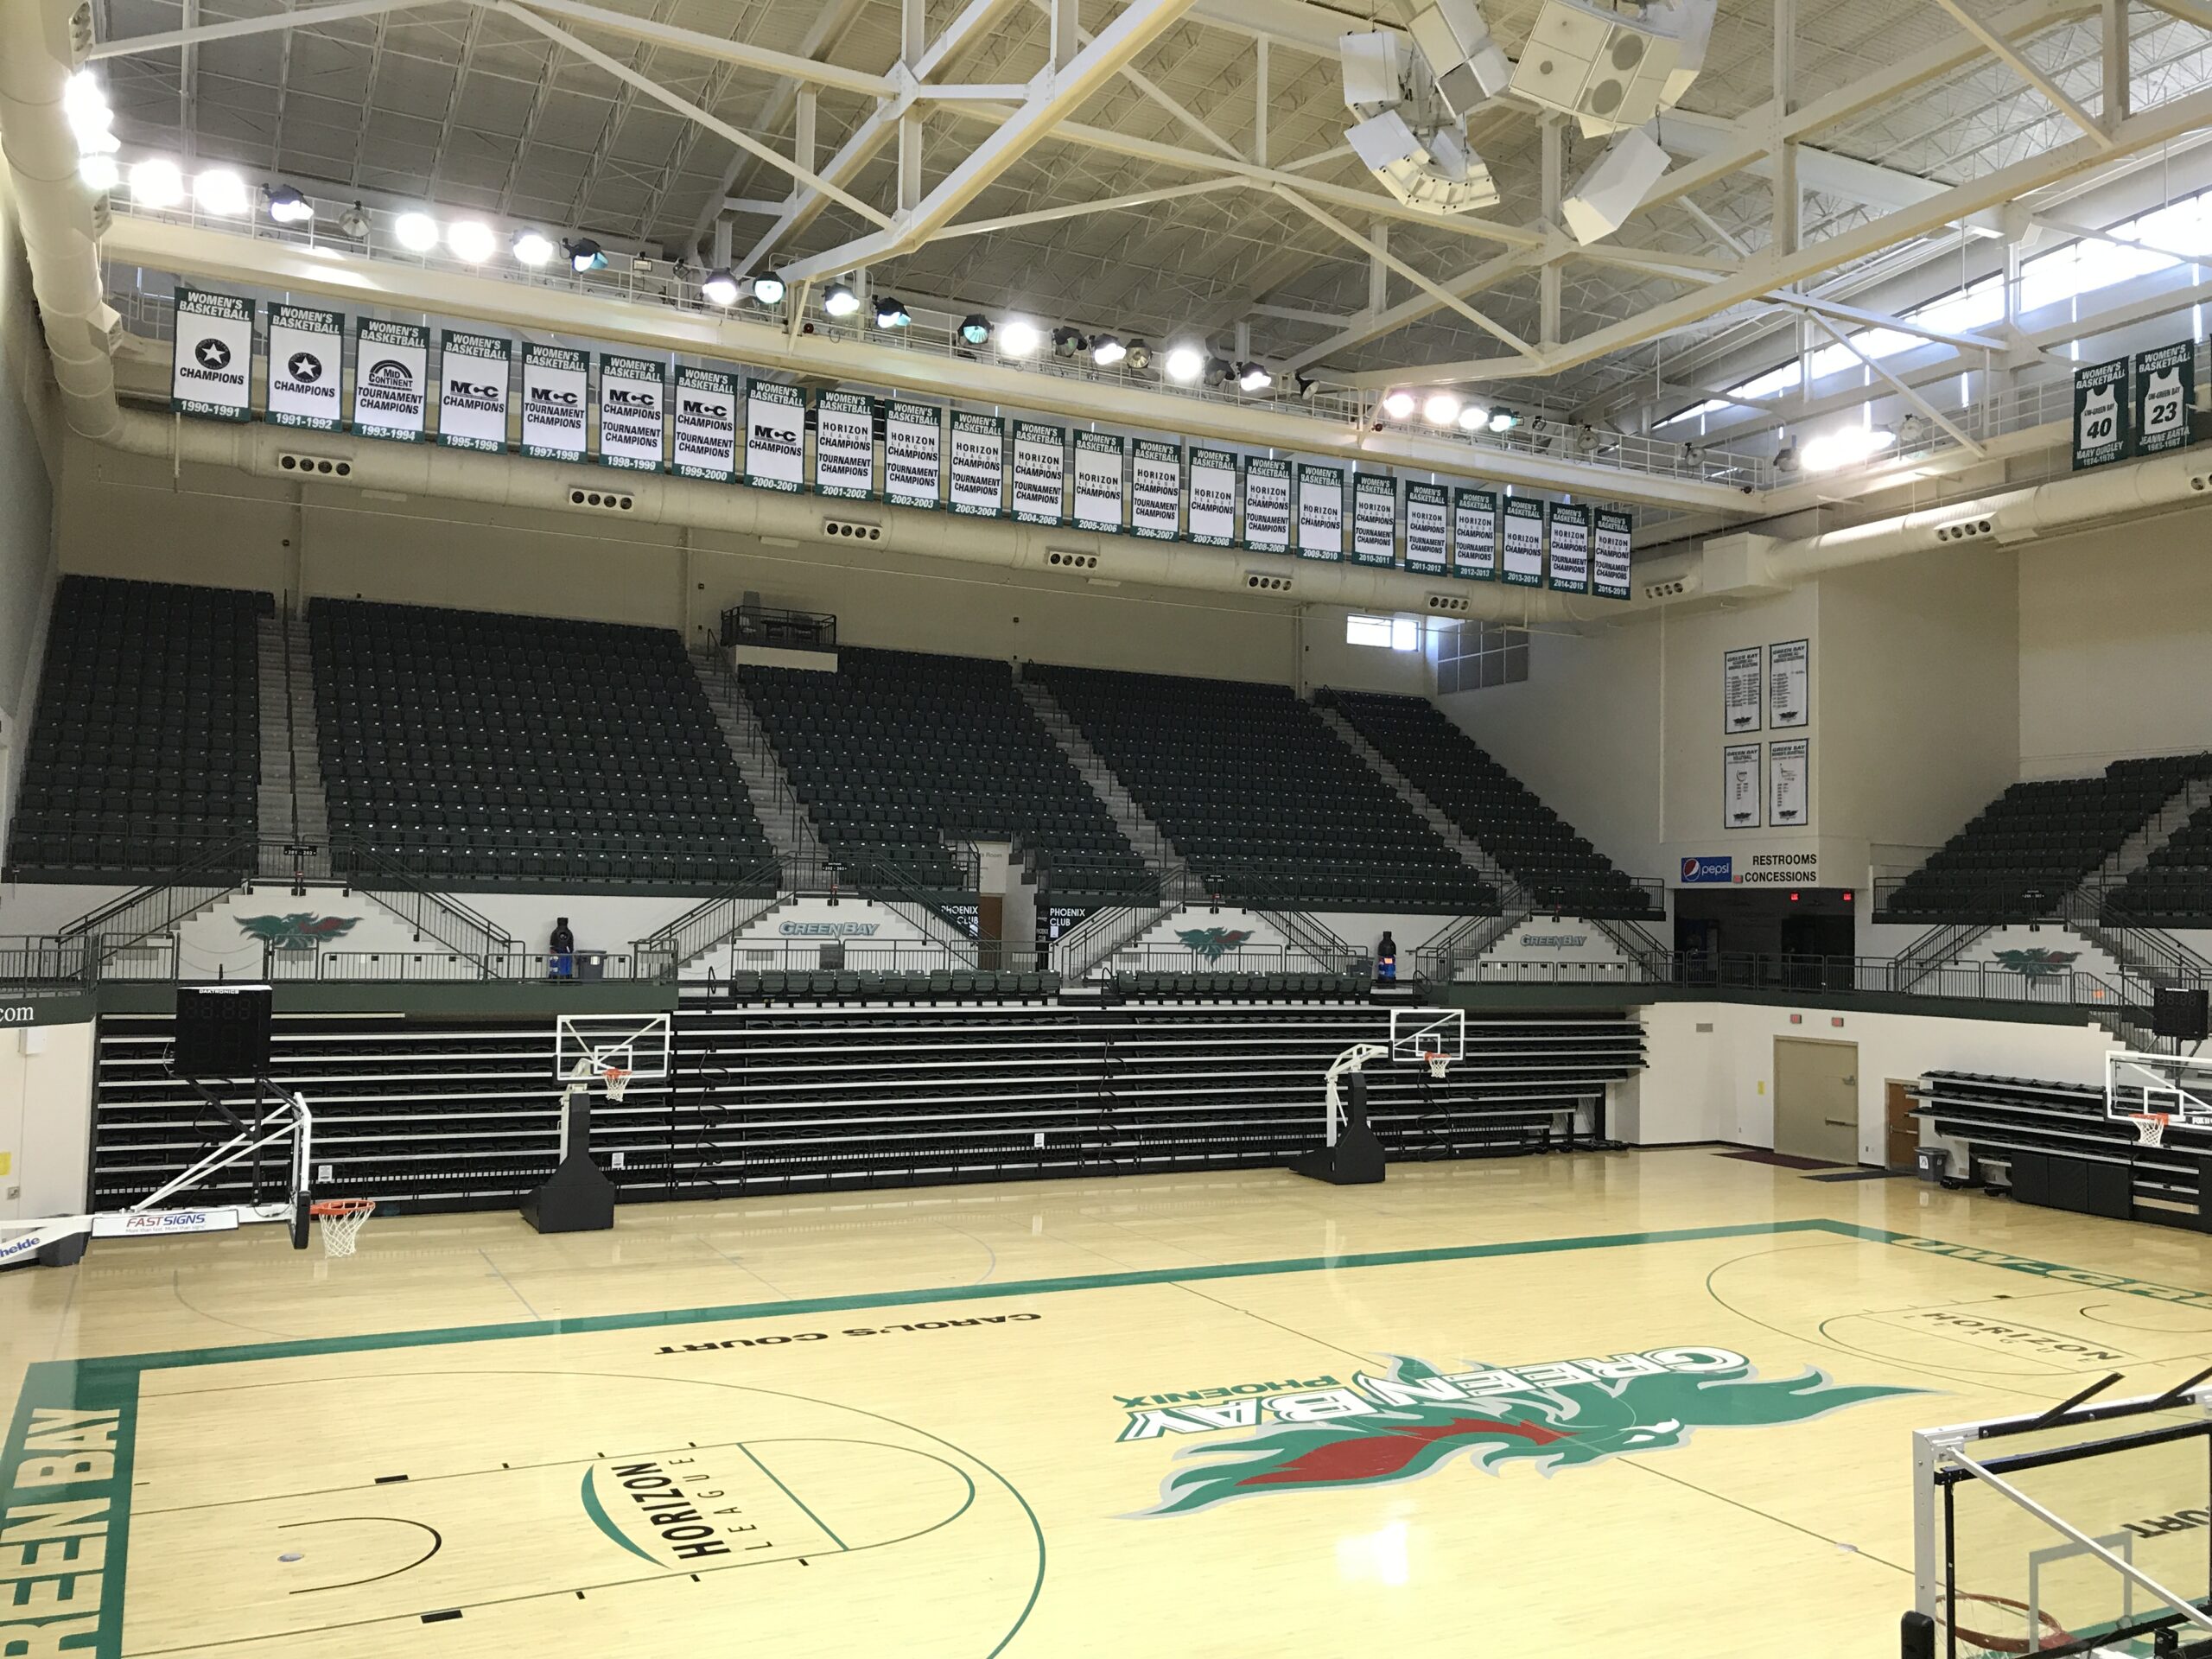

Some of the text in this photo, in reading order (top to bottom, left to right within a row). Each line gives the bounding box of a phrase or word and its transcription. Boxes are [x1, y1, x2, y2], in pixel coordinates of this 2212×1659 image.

[188, 292, 243, 309] WOMEN'S
[179, 301, 250, 321] BASKETBALL
[280, 307, 333, 323] WOMEN'S
[272, 315, 340, 334] BASKETBALL
[369, 321, 419, 337] WOMEN'S
[360, 329, 425, 347] BASKETBALL
[453, 334, 501, 349] WOMEN'S
[445, 342, 507, 359] BASKETBALL
[532, 346, 579, 361] WOMEN'S
[2145, 345, 2185, 363] WOMEN'S
[526, 355, 585, 372] BASKETBALL
[610, 358, 655, 372] WOMEN'S
[2139, 353, 2190, 372] BASKETBALL
[180, 367, 245, 385] CHAMPIONS
[604, 365, 661, 382] BASKETBALL
[685, 369, 728, 385] WOMEN'S
[2082, 362, 2121, 379] WOMEN'S
[369, 373, 413, 387] CONTINENT
[679, 378, 734, 394] BASKETBALL
[2076, 371, 2126, 389] BASKETBALL
[274, 380, 335, 397] CHAMPIONS
[359, 387, 423, 404] TOURNAMENT
[757, 382, 798, 397] WOMEN'S
[359, 398, 419, 414] CHAMPIONS
[443, 396, 505, 413] CHAMPIONS
[751, 391, 803, 407] BASKETBALL
[826, 392, 866, 405] WOMEN'S
[181, 401, 240, 417] 1990-1991
[525, 403, 584, 419] TOURNAMENT
[604, 404, 661, 420] CHAMPIONS
[820, 400, 871, 415] BASKETBALL
[894, 403, 932, 416] WOMEN'S
[2152, 402, 2177, 424] 23
[276, 413, 333, 429] 1991-1992
[527, 414, 581, 429] CHAMPIONS
[677, 415, 733, 431] CHAMPIONS
[888, 410, 938, 426] BASKETBALL
[959, 414, 996, 426] WOMEN'S
[361, 425, 416, 442] 1993-1994
[603, 422, 661, 437] TOURNAMENT
[823, 422, 868, 435] HORIZON
[954, 422, 1001, 435] BASKETBALL
[1022, 423, 1058, 436] WOMEN'S
[2087, 418, 2112, 438] 40
[446, 435, 499, 451] 1995-1996
[606, 433, 658, 448] CHAMPIONS
[677, 432, 733, 448] TOURNAMENT
[820, 437, 870, 451] CHAMPIONS
[892, 432, 935, 446] HORIZON
[1017, 431, 1062, 445] BASKETBALL
[1082, 432, 1116, 445] WOMEN'S
[529, 447, 579, 461] 1997-1998
[679, 442, 729, 458] CHAMPIONS
[749, 440, 802, 456] CHAMPIONS
[888, 447, 938, 461] CHAMPIONS
[957, 442, 998, 454] HORIZON
[1077, 441, 1121, 454] BASKETBALL
[1141, 442, 1173, 453] WOMEN'S
[819, 454, 870, 467] TOURNAMENT
[1019, 452, 1059, 465] HORIZON
[1135, 449, 1179, 462] BASKETBALL
[1198, 450, 1230, 461] WOMEN'S
[607, 456, 656, 471] 1998-1999
[821, 464, 868, 476] CHAMPIONS
[887, 463, 938, 477] TOURNAMENT
[953, 457, 1000, 471] CHAMPIONS
[1193, 457, 1235, 470] BASKETBALL
[1253, 459, 1285, 469] WOMEN'S
[680, 466, 727, 480] 1999-2000
[1015, 466, 1061, 480] CHAMPIONS
[1079, 472, 1118, 485] HORIZON
[1138, 469, 1175, 481] HORIZON
[1248, 466, 1289, 478] BASKETBALL
[1306, 467, 1337, 477] WOMEN'S
[752, 477, 797, 492] 2000-2001
[889, 474, 935, 486] CHAMPIONS
[823, 486, 866, 499] 2001-2002
[1077, 486, 1120, 499] CHAMPIONS
[1135, 483, 1178, 496] CHAMPIONS
[1195, 488, 1231, 500] HORIZON
[891, 495, 933, 508] 2002-2003
[1192, 502, 1233, 514] CHAMPIONS
[956, 505, 996, 517] 2003-2004
[1017, 512, 1057, 524] 2004-2005
[1079, 520, 1116, 532] 2005-2006
[1753, 855, 1817, 866] RESTROOMS
[1702, 862, 1729, 875] pepsi
[1745, 872, 1816, 882] CONCESSIONS
[1050, 908, 1085, 917] PHOENIX
[779, 921, 880, 938] GREEN BAY
[1050, 918, 1071, 926] CLUB
[1520, 934, 1587, 951] GREEN BAY
[0, 1237, 40, 1257] helde
[653, 1313, 1042, 1355] CAROL'S COURT
[1922, 1312, 2122, 1361] HORIZON
[1114, 1373, 1339, 1410] PHOENIX
[1116, 1344, 1751, 1443] GREEN BAY
[13, 1408, 121, 1490] BAY
[611, 1462, 731, 1560] HORIZON
[668, 1458, 773, 1550] LEAGUE
